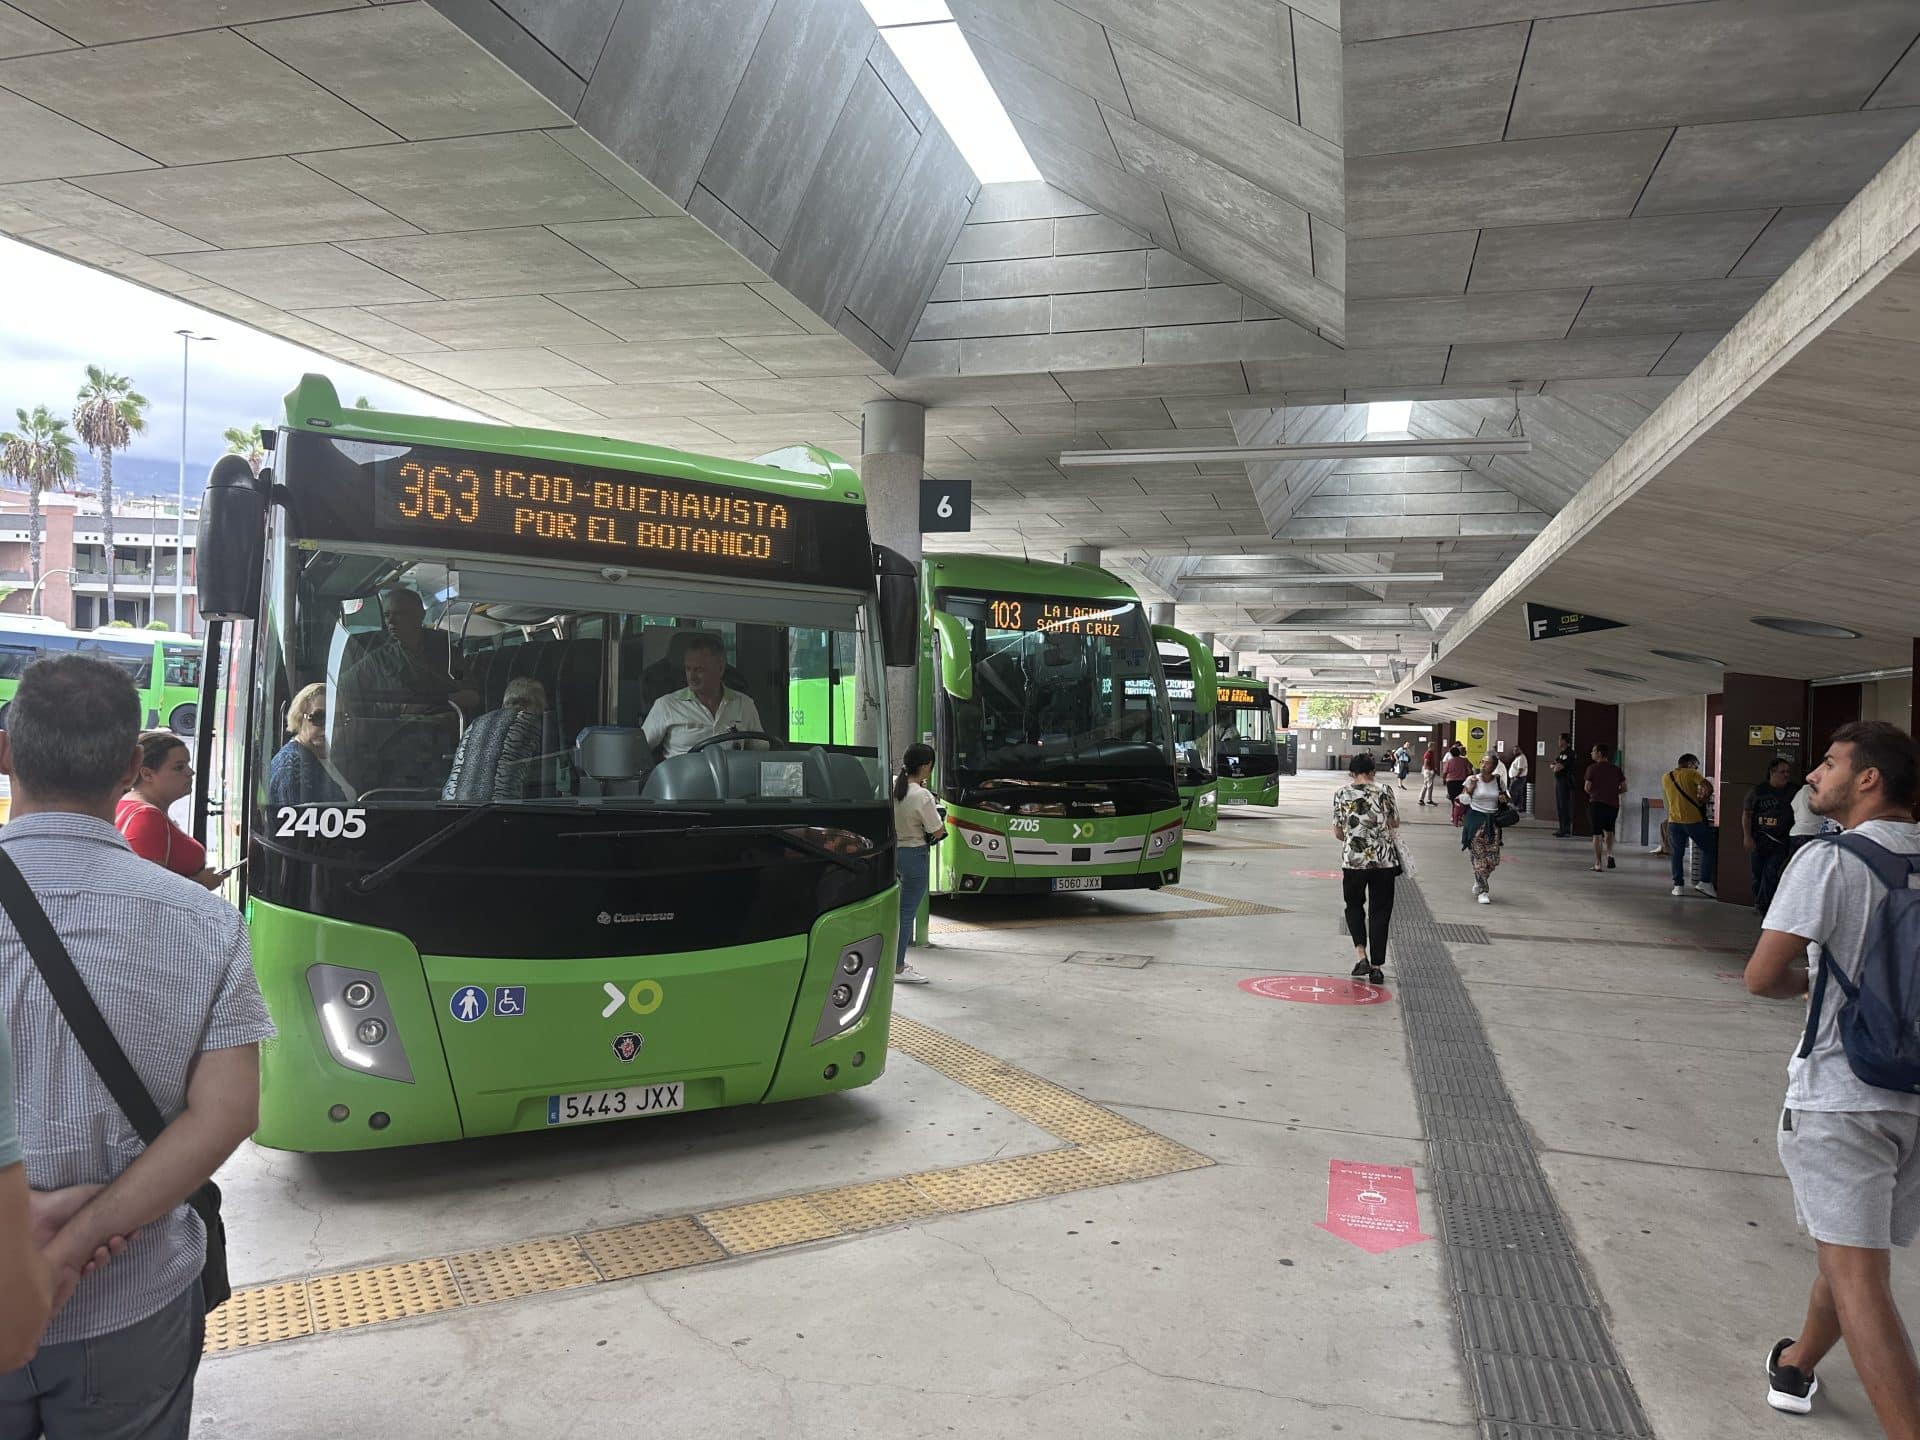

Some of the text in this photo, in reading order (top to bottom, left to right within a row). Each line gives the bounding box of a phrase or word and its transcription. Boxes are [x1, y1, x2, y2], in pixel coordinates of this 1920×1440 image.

[400, 463, 788, 528] 363 ICOD-BUENAVISTA
[937, 495, 953, 518] 6
[514, 508, 771, 559] POR EL BOTANICO
[990, 601, 1021, 629] 103
[1044, 604, 1060, 617] LA
[1086, 623, 1120, 636] CRUZ
[1533, 620, 1547, 638] F
[1217, 660, 1224, 668] 3
[1434, 683, 1441, 691] E
[275, 806, 367, 838] 2405
[1008, 818, 1040, 832] 2705
[1058, 877, 1100, 889] 5060 JXX
[566, 1085, 679, 1118] 5443 JXX
